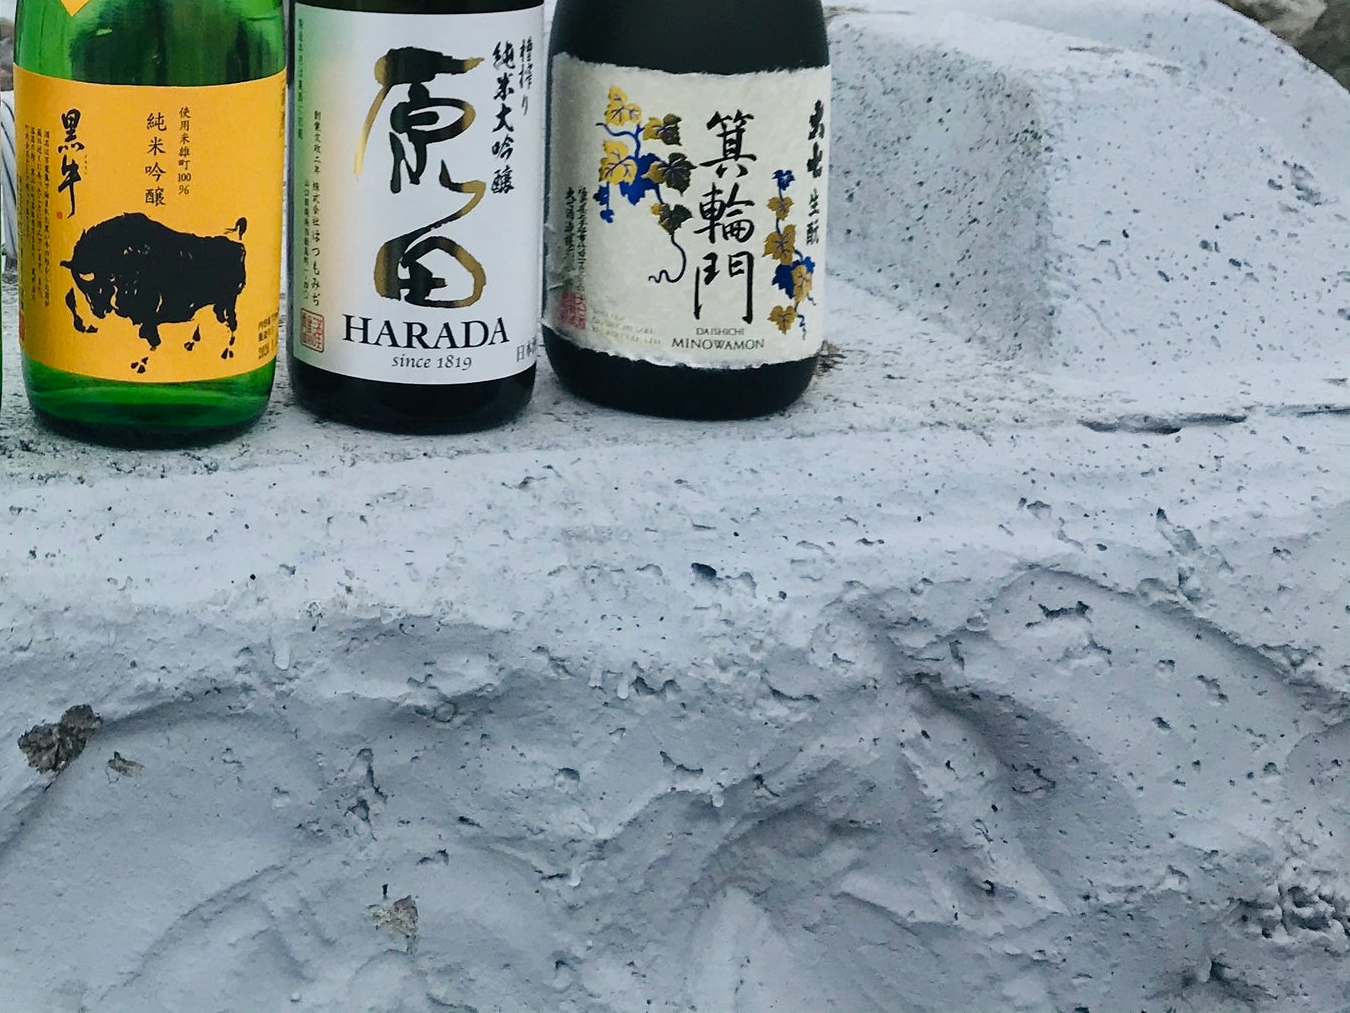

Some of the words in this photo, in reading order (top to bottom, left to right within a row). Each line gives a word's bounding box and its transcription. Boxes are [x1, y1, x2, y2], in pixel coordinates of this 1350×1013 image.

[491, 41, 515, 194] 純米大吟醸
[57, 108, 85, 219] 黒牛
[144, 111, 167, 206] 純米吟醸
[342, 313, 510, 351] HARADA
[391, 353, 431, 369] since
[436, 354, 473, 371] 1819
[672, 338, 765, 350] MINOWAMON
